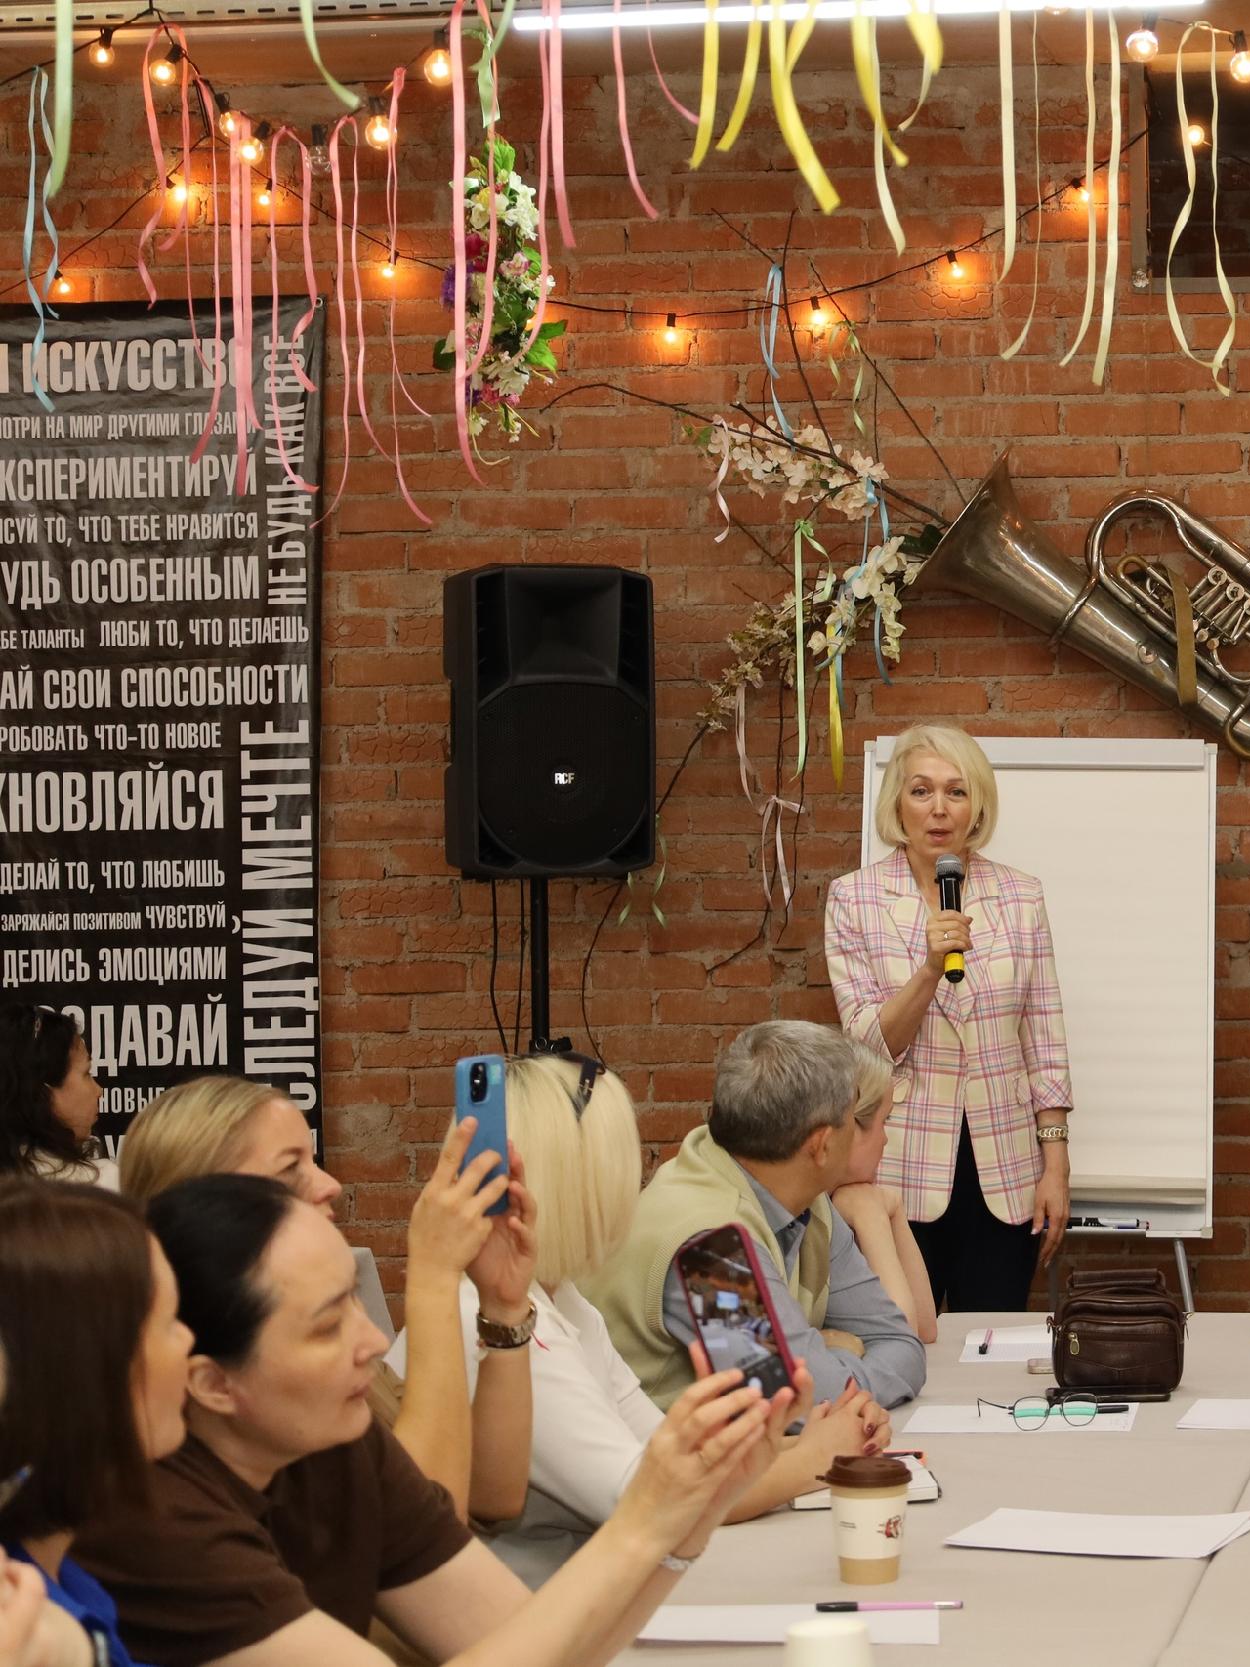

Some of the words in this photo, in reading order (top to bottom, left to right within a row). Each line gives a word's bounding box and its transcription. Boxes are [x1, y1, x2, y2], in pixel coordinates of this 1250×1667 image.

[262, 334, 306, 393] ВСЕ
[0, 416, 41, 440] ОТРИ
[46, 415, 65, 439] НА
[70, 414, 104, 439] МИР
[107, 412, 180, 441] ДРУГИМИ
[264, 402, 305, 464] КАК
[0, 513, 38, 544] СУЙ
[44, 516, 72, 548] ТО,
[78, 515, 112, 543] ЧТО
[117, 514, 161, 542] ТЕБЕ
[166, 511, 259, 541] НРАВИТСЯ
[265, 474, 312, 560] БУДЬ
[0, 560, 61, 611] УДЬ
[70, 555, 260, 604] ОСОБЕННЫМ
[267, 567, 307, 605] НЕ
[0, 630, 18, 649] БЕ
[20, 628, 85, 649] ТАЛАНТЫ
[99, 620, 150, 647] ЛЮБИ
[156, 619, 184, 649] ТО,
[189, 618, 223, 645] ЧТО
[228, 615, 310, 647] ДЕЛАЕШЬ
[0, 664, 34, 710] АЙ
[43, 668, 111, 709] СВОИ
[120, 663, 309, 708] СПОСОБНОСТИ
[94, 723, 160, 751] ЧТО-ТО
[165, 721, 222, 749] НОВОЕ
[554, 772, 575, 785] RCF
[240, 719, 314, 891] МЕЧТЕ
[0, 858, 60, 895] ДЕЛАЙ
[65, 861, 95, 893] ТО,
[101, 860, 135, 889] ЧТО
[141, 859, 225, 889] ЛЮБИШЬ
[1, 911, 70, 931] ЗАРЯЖАЙСЯ
[73, 911, 142, 931] ПОЗИТИВОМ
[145, 900, 226, 929] ЧУВСТВУЙ
[2, 948, 91, 988] ДЕЛИСЬ
[98, 946, 227, 986] ЭМОЦИЯМИ
